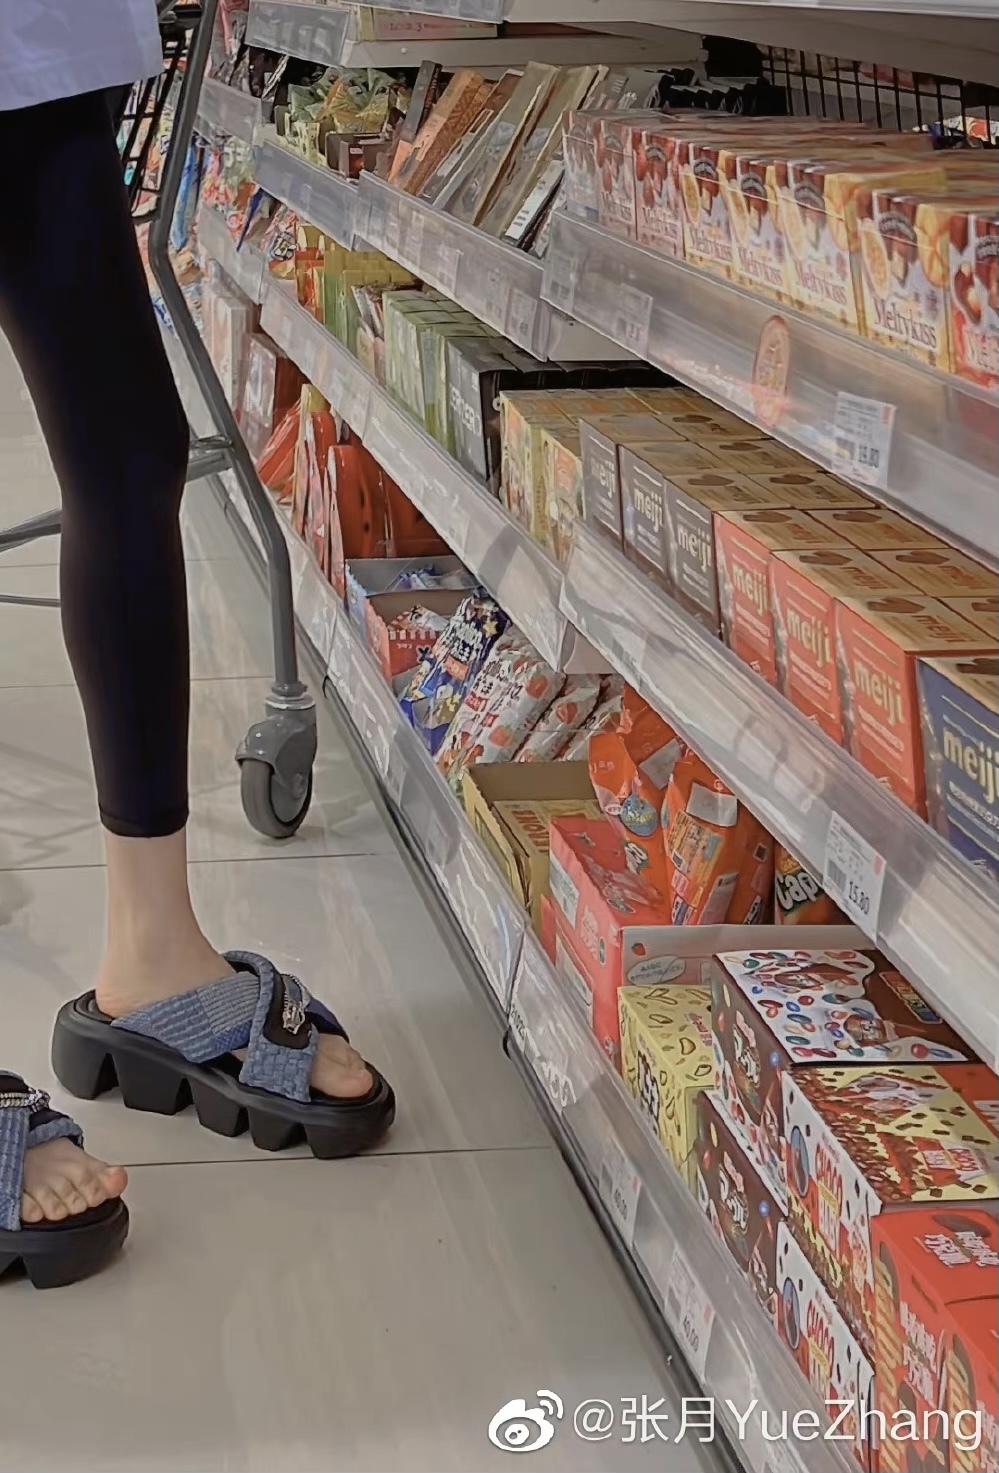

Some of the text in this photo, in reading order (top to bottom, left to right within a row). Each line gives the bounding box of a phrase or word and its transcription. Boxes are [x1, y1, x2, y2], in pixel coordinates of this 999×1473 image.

[633, 485, 664, 533] meiji
[676, 523, 712, 574] meiji
[732, 561, 769, 617] meiji
[786, 607, 833, 668] meiji
[854, 660, 905, 726] meiji
